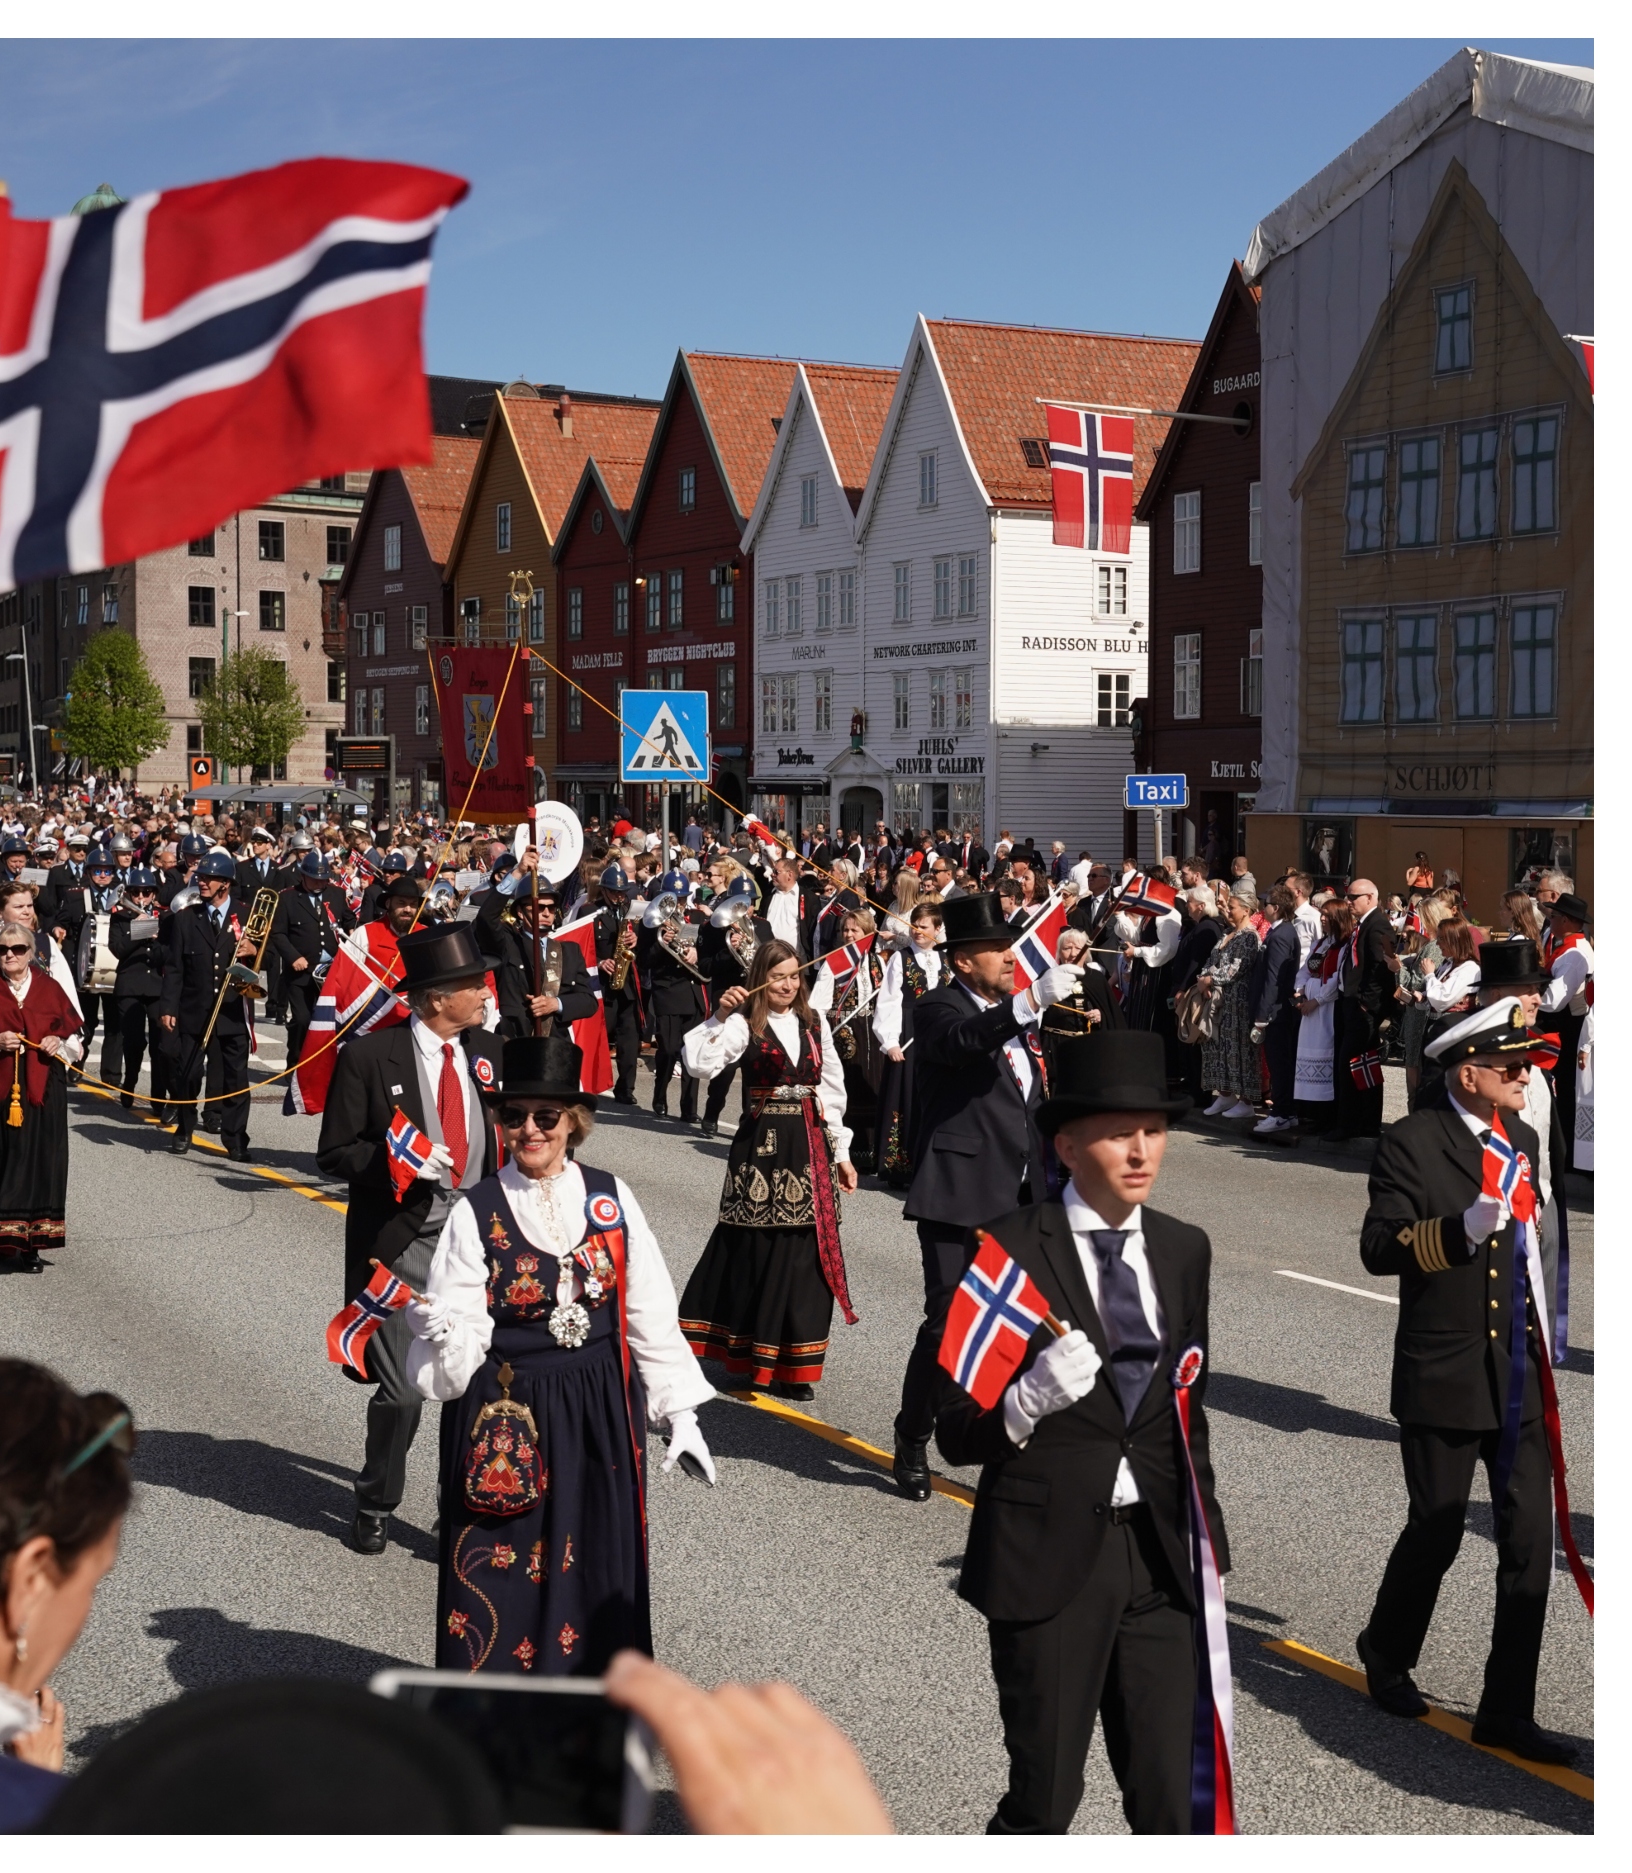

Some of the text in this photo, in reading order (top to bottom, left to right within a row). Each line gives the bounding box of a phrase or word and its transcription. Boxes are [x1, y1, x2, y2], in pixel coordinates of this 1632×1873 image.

[1213, 371, 1261, 395] BUGAARD
[647, 641, 736, 664] BRYGGEN NIGHTCLUB
[873, 644, 910, 659] NETWORK
[911, 640, 961, 656] CHARTERING
[1021, 636, 1098, 652] RADISSON
[1104, 638, 1131, 653] BLU
[572, 653, 601, 670] MADAM
[895, 756, 986, 774] SILVER GALLERY
[1394, 765, 1497, 791] SCHJØTT
[1135, 780, 1178, 800] Taxi
